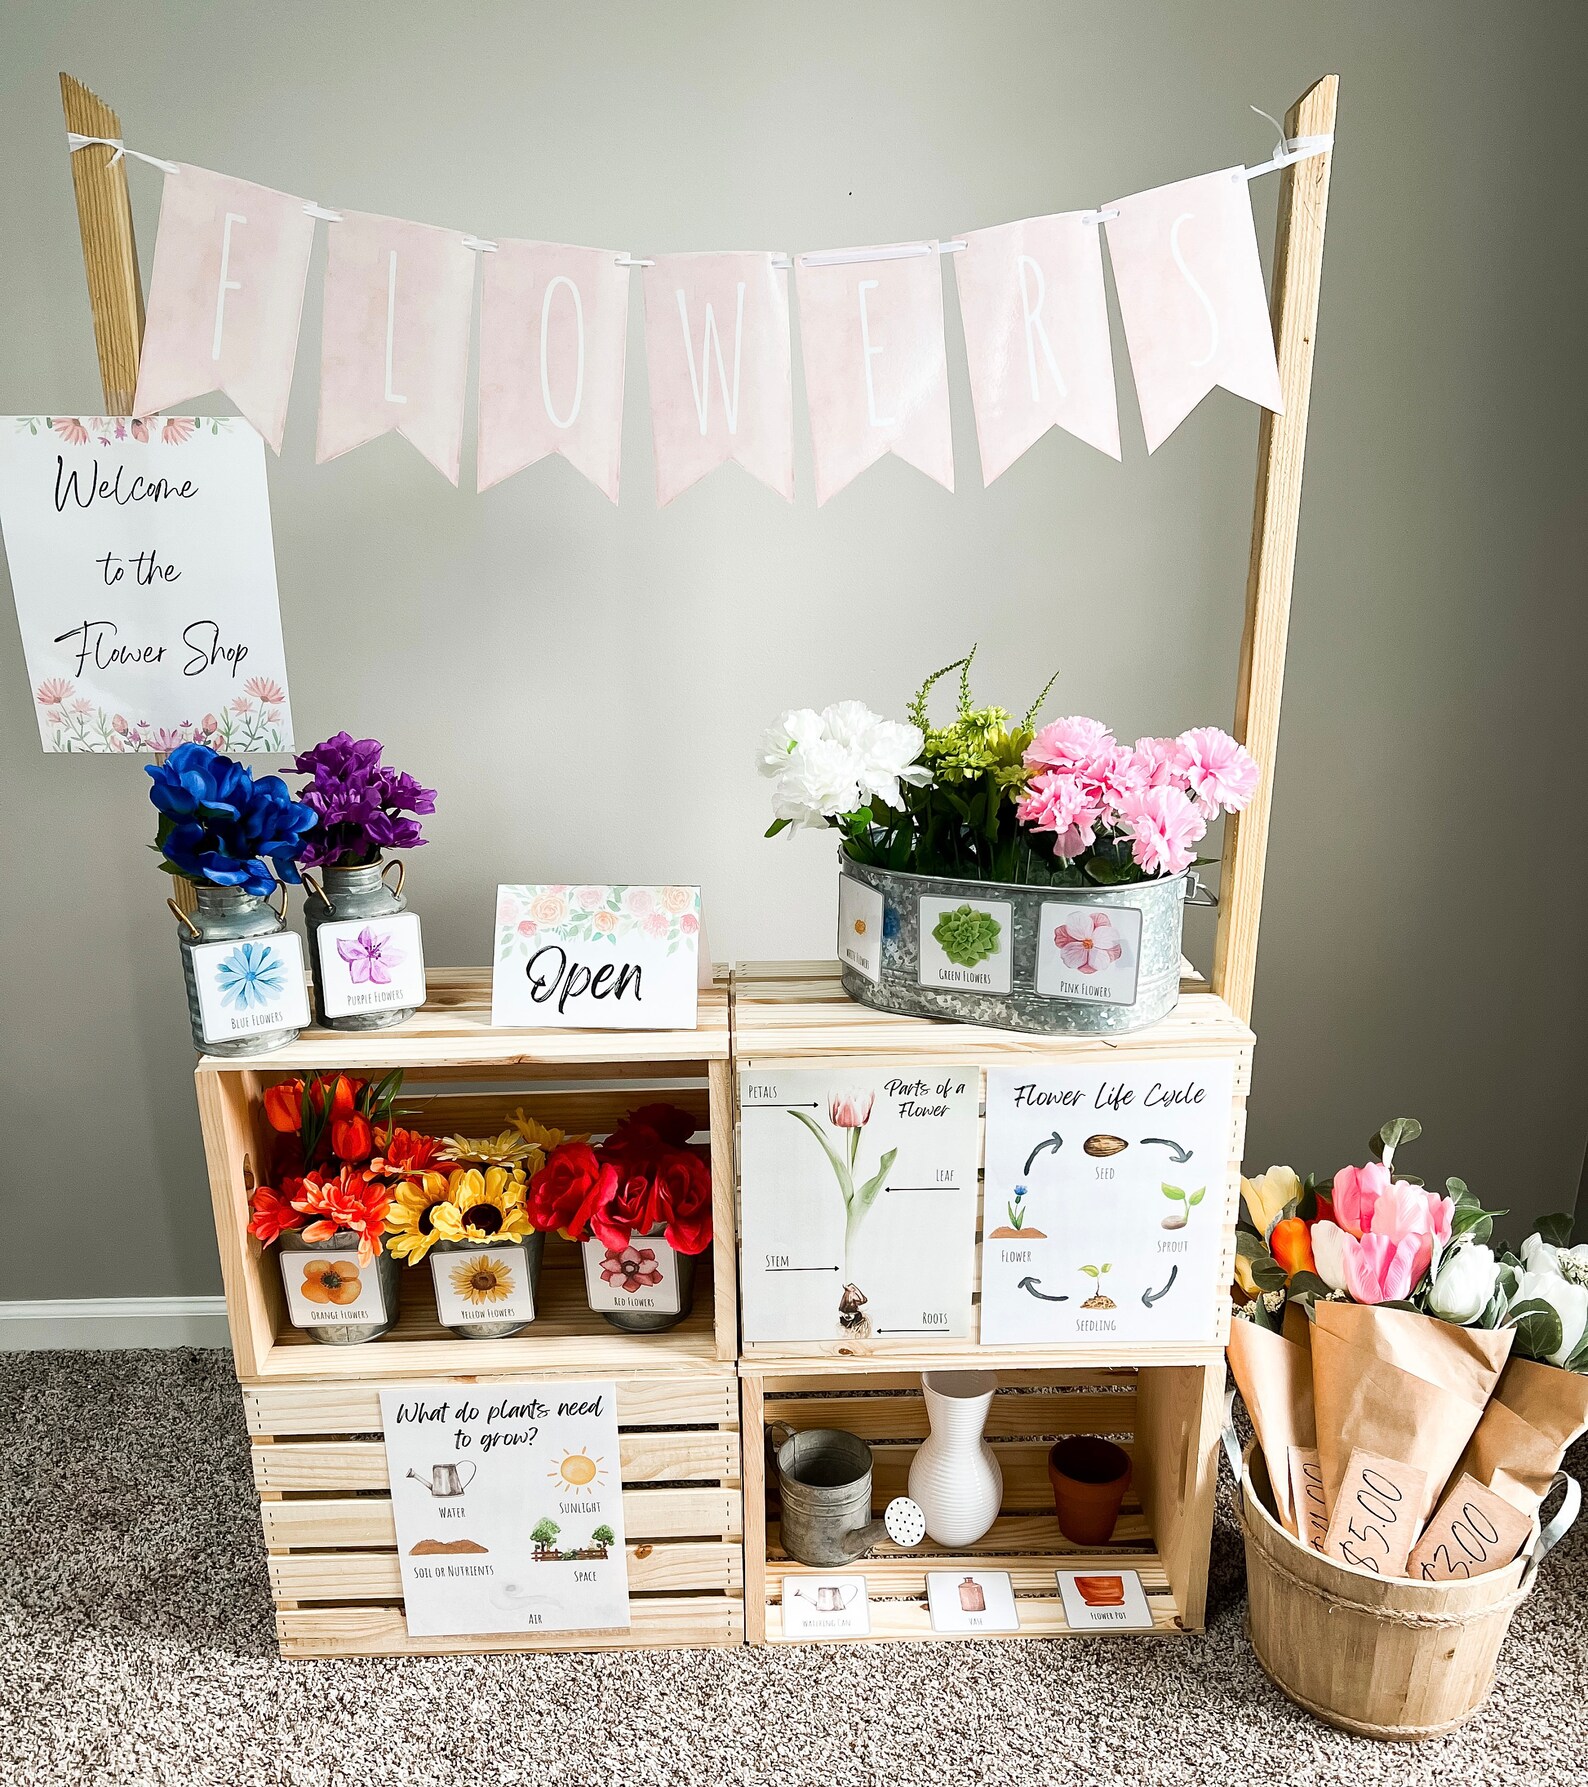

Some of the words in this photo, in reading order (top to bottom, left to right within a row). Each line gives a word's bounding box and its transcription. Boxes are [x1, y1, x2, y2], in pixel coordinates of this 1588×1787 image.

[54, 454, 199, 512] Welcome
[96, 551, 124, 585] to
[128, 549, 181, 585] the
[53, 620, 167, 678] Flower
[182, 620, 248, 678] Shop
[525, 945, 642, 1015] Open
[938, 968, 961, 982] GREEN
[962, 970, 991, 985] FLOWERS
[1060, 980, 1079, 994] PINK
[1081, 983, 1112, 998] FLOWERS
[346, 993, 372, 1006] PURPLE
[373, 989, 404, 1003] FLOWERS
[230, 1014, 249, 1030] BLUE
[251, 1010, 284, 1027] FLOWERS
[748, 1084, 778, 1099] PETALS
[884, 1078, 931, 1097] Parts
[936, 1077, 953, 1099] of
[955, 1083, 966, 1094] a
[1013, 1083, 1086, 1108] Flower
[1094, 1081, 1136, 1111] Life
[1143, 1081, 1207, 1108] Cycle
[898, 1100, 951, 1119] Flower
[935, 1168, 955, 1182] LEAF
[1095, 1166, 1115, 1180] SEED
[1157, 1239, 1189, 1253] SPROUT
[765, 1254, 790, 1268] STEM
[1001, 1249, 1032, 1263] FLOWER
[614, 1296, 626, 1307] RED
[627, 1297, 655, 1308] FLOWERS
[310, 1310, 338, 1321] ORANGE
[340, 1309, 369, 1320] FLOWERS
[460, 1310, 486, 1320] YELLOW
[486, 1308, 516, 1318] FLOWERS
[922, 1311, 948, 1325] ROOTS
[1075, 1318, 1117, 1332] SEEDLING
[396, 1402, 451, 1424] What
[454, 1401, 480, 1424] do
[486, 1398, 550, 1425] plants
[557, 1395, 604, 1418] need
[453, 1428, 472, 1450] to
[479, 1426, 539, 1453] grow?
[438, 1506, 466, 1519] WATER
[558, 1501, 602, 1515] SUNLIGHT
[1338, 1468, 1403, 1574] $5.00
[413, 1566, 433, 1579] SOIL
[434, 1567, 446, 1578] OR
[447, 1564, 495, 1577] NUTRIENTS
[573, 1570, 597, 1583] SPACE
[528, 1613, 543, 1625] AIR
[1090, 1612, 1114, 1621] FLOWER
[1115, 1611, 1127, 1620] POT
